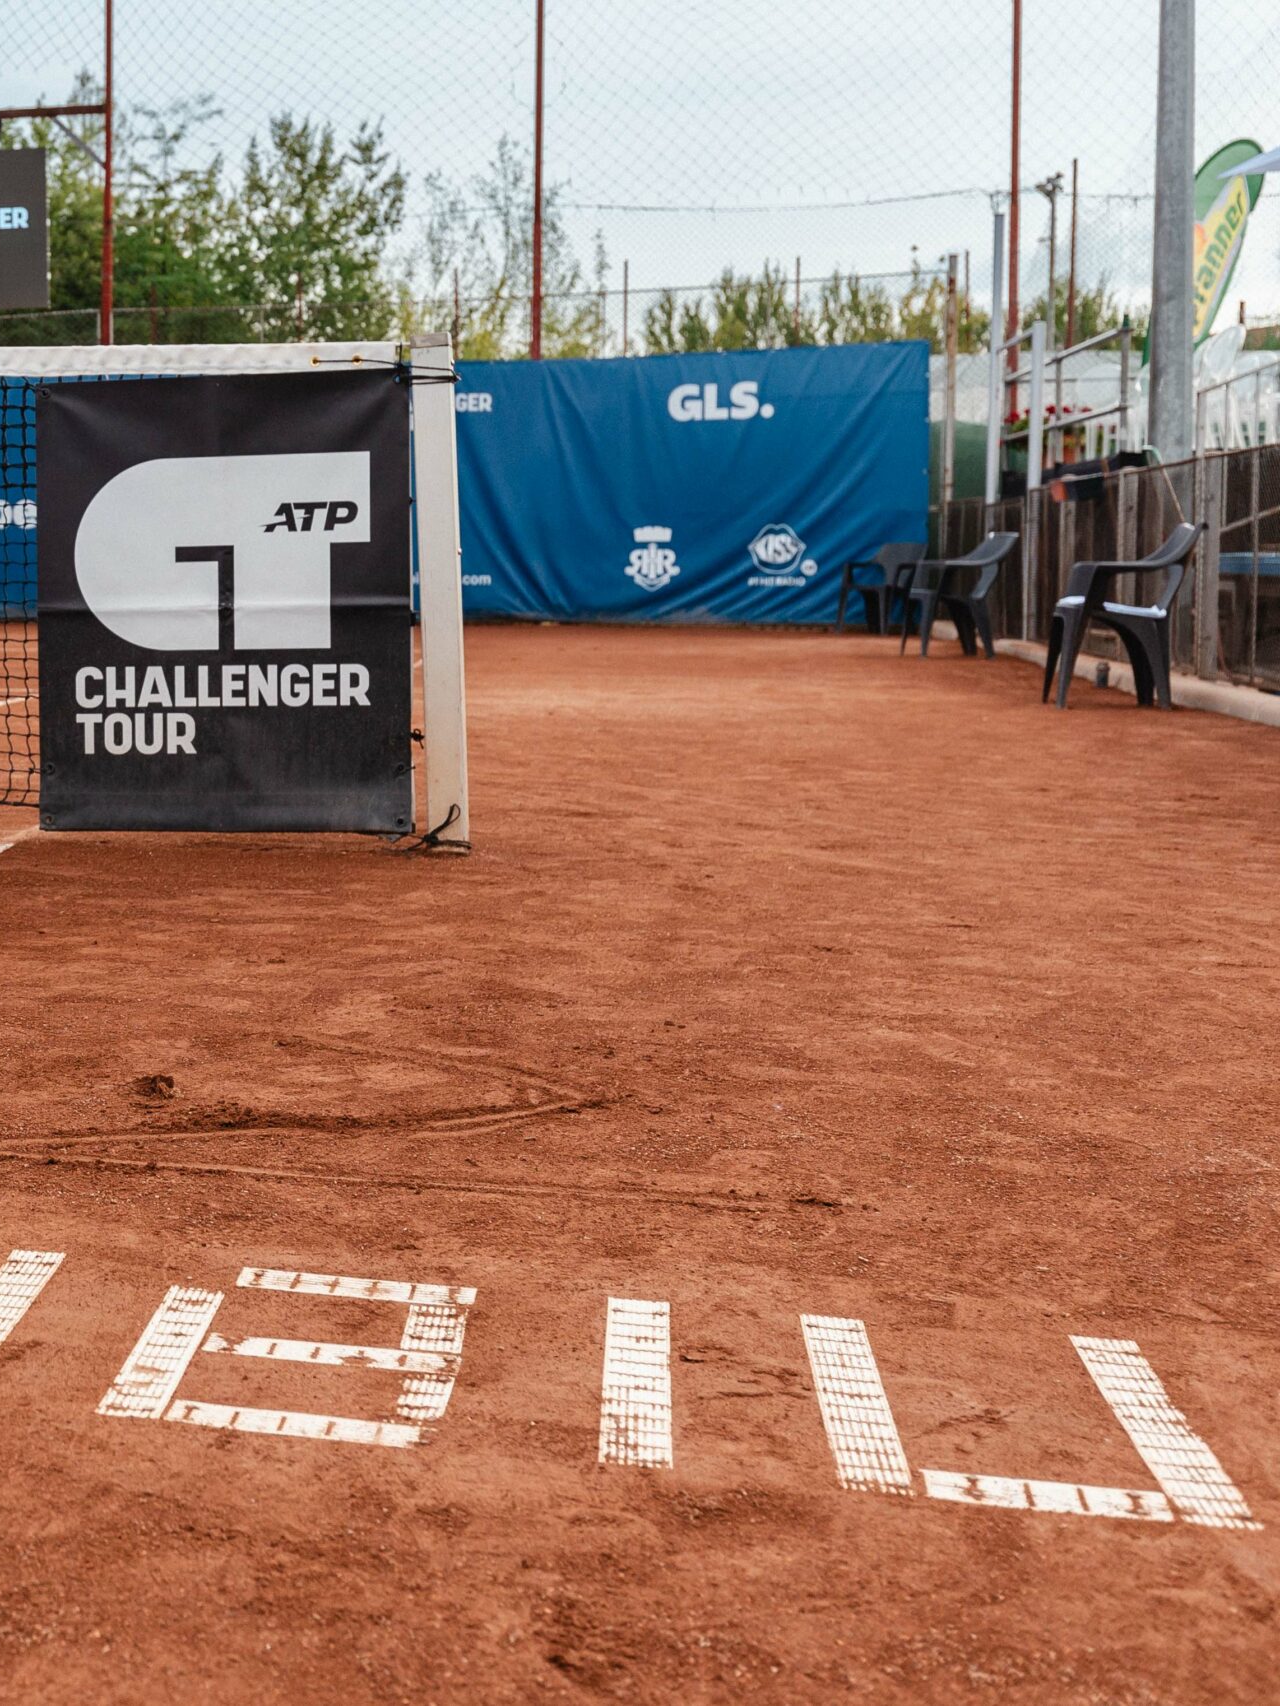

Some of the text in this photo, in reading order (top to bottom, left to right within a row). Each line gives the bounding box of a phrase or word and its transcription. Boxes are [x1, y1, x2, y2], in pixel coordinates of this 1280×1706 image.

[259, 501, 358, 533] ATP
[75, 663, 371, 708] CHALLENGER
[76, 712, 197, 755] TOUR
